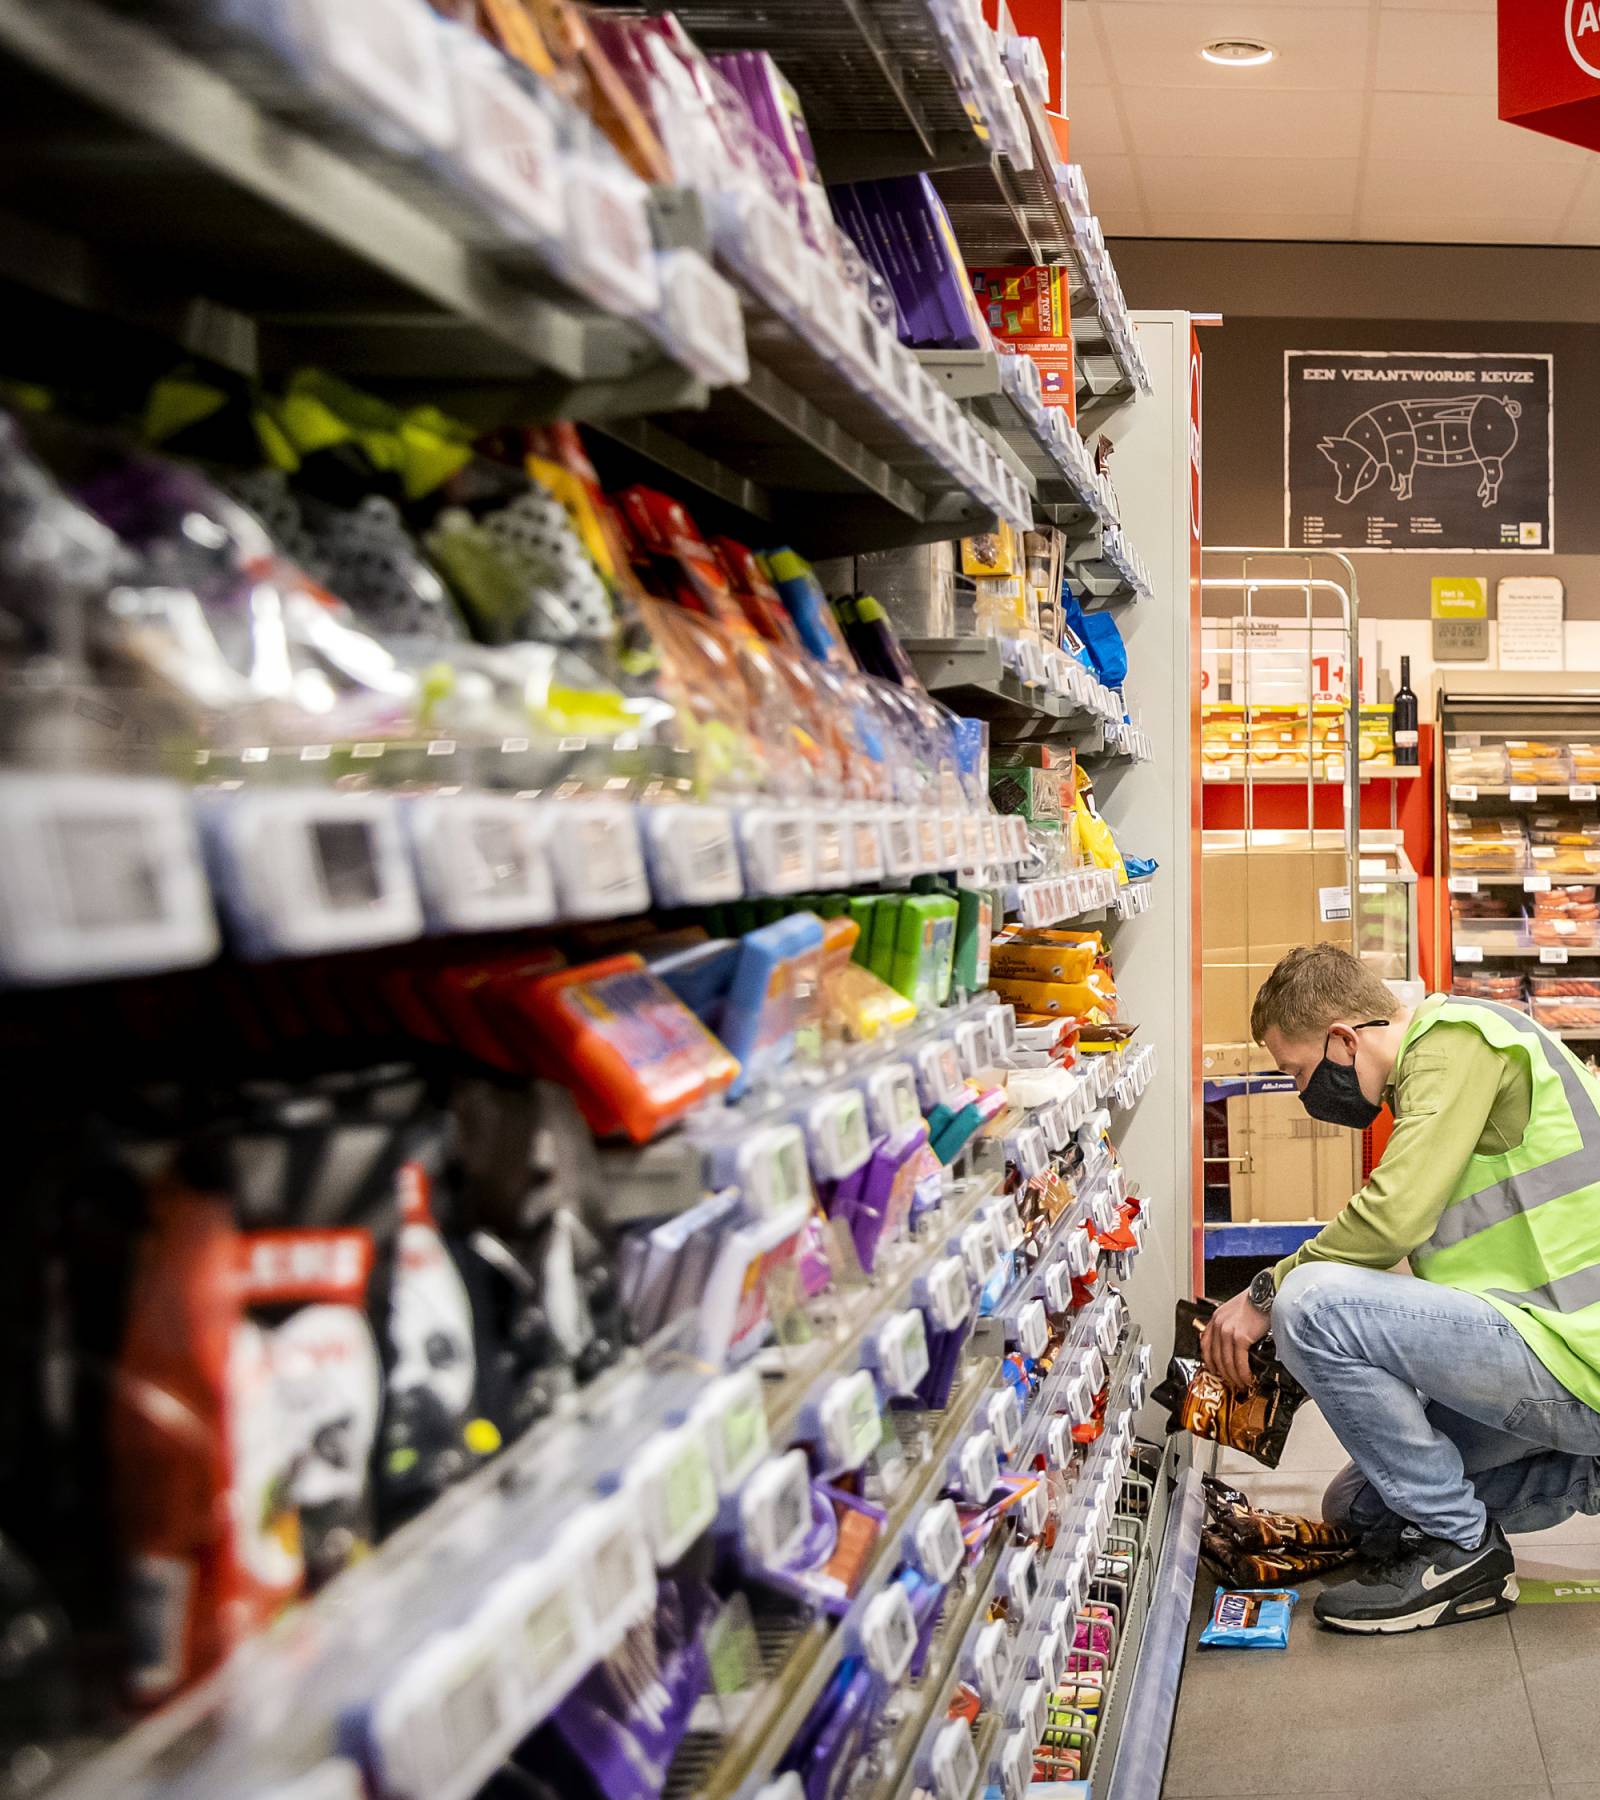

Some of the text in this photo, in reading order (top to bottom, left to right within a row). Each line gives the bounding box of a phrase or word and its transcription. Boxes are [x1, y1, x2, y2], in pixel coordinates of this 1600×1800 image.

[1303, 369, 1534, 383] EEN VERANTWOORDE KEUZE
[1236, 629, 1278, 637] rokworst
